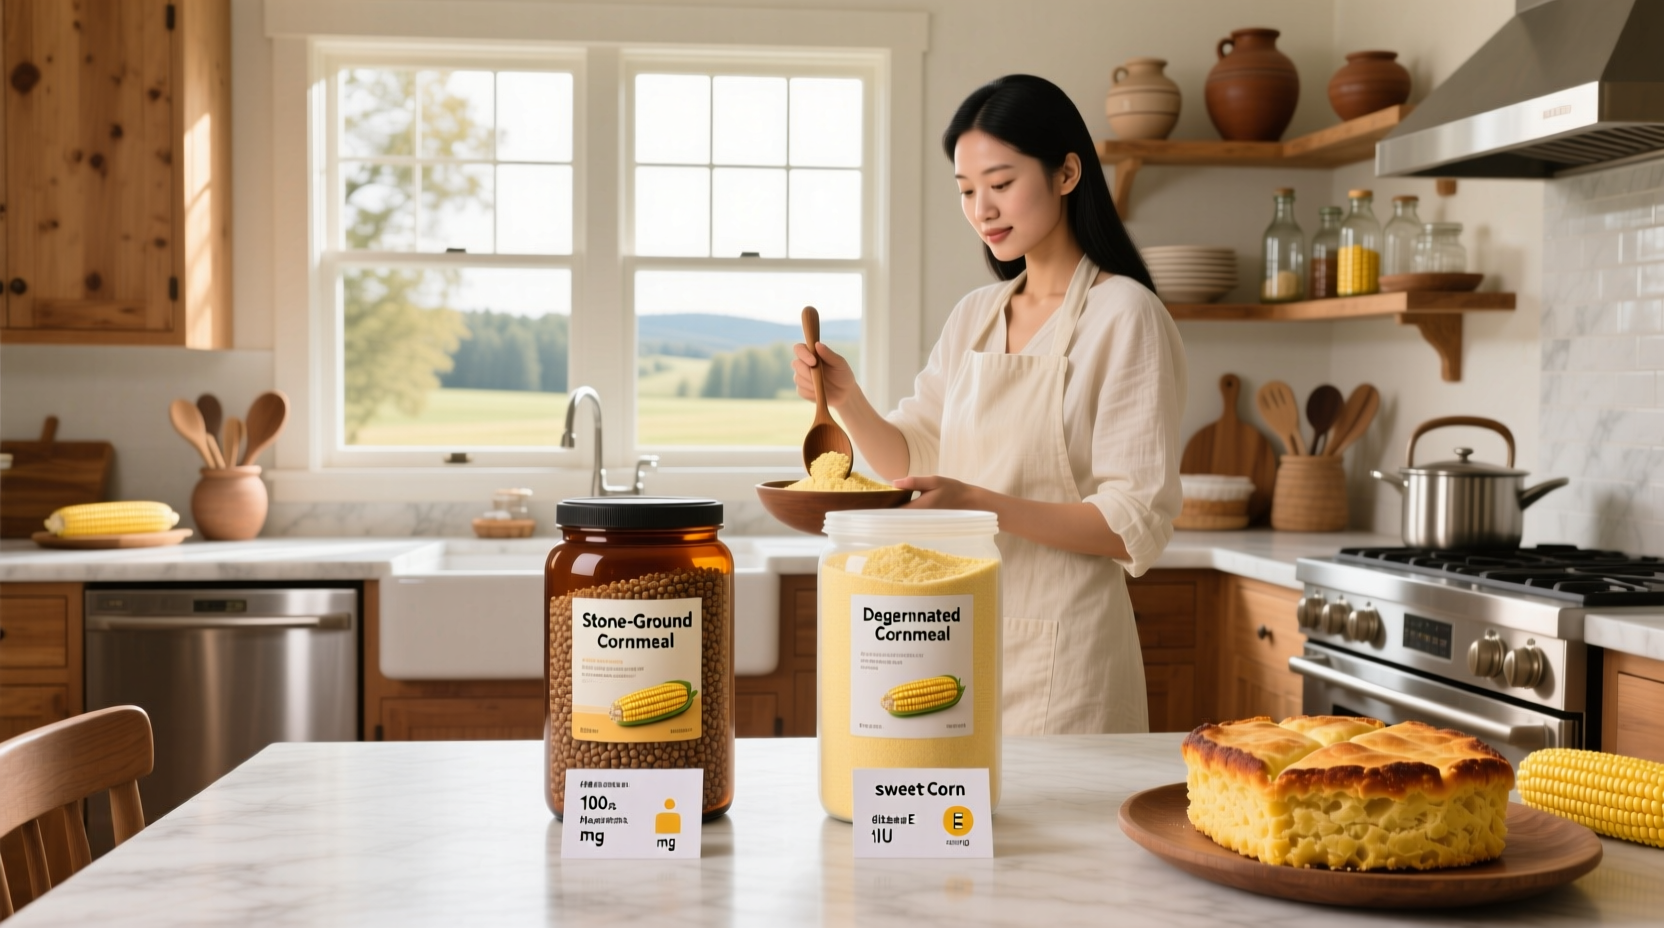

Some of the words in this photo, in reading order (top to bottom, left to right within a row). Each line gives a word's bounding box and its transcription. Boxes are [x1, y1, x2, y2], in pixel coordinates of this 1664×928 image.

[582, 611, 692, 629] Stone-Ground
[597, 632, 674, 649] Cornmeal
[875, 625, 950, 642] Cornmeal
[875, 782, 925, 796] sweet
[927, 781, 965, 796] Corn
[580, 830, 605, 847] mg
[656, 838, 676, 852] mg
